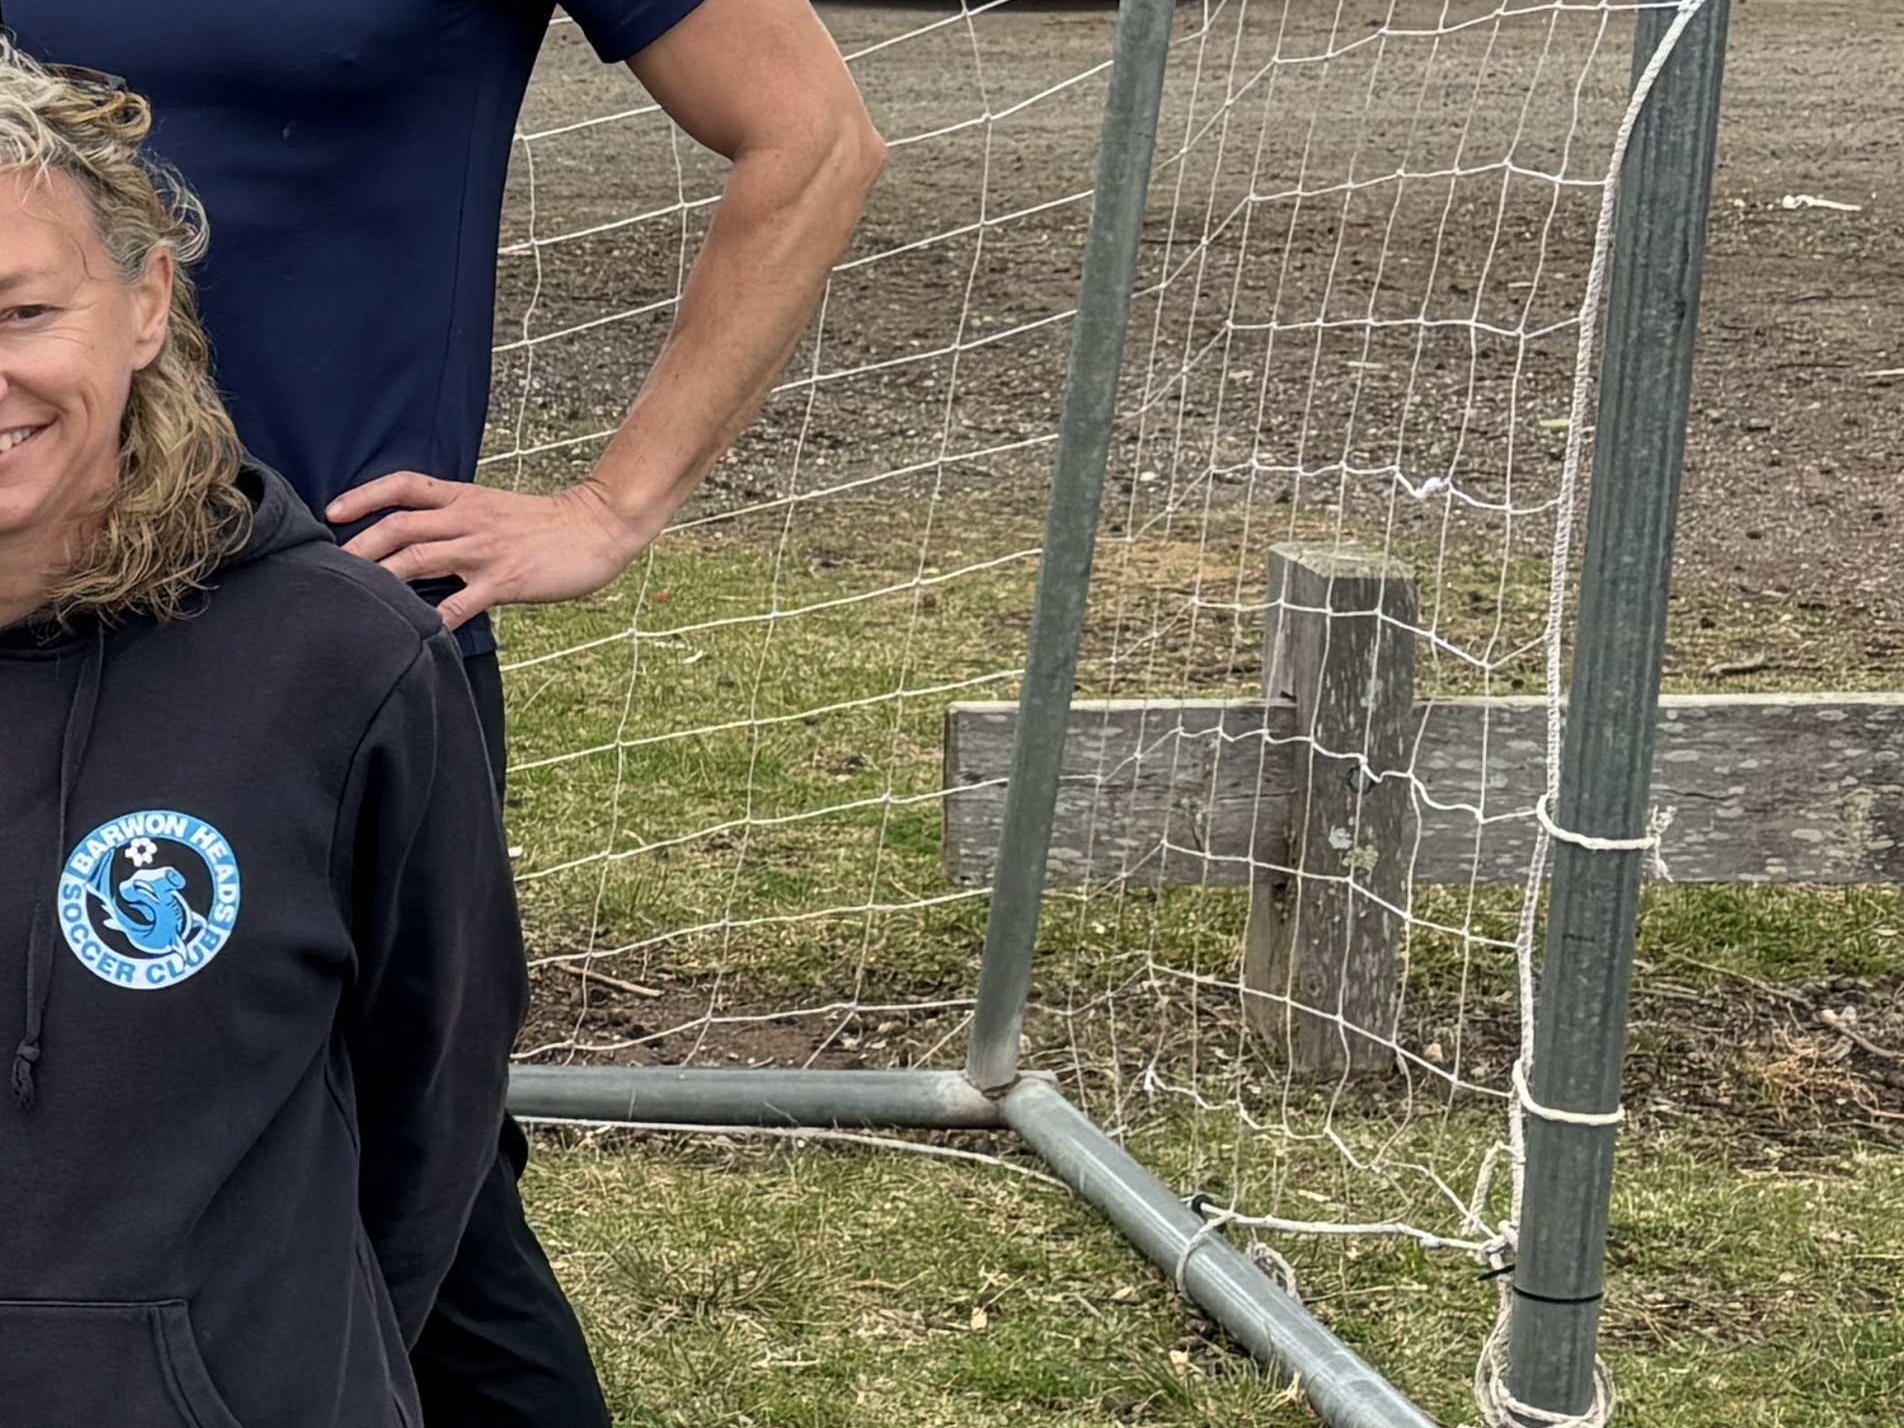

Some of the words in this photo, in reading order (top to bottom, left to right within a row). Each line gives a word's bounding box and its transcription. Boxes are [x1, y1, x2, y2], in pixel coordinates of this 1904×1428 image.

[70, 813, 189, 874] BARWON
[190, 826, 237, 923] HEADS
[63, 884, 136, 983] SOCCER
[145, 930, 221, 984] CLUB
